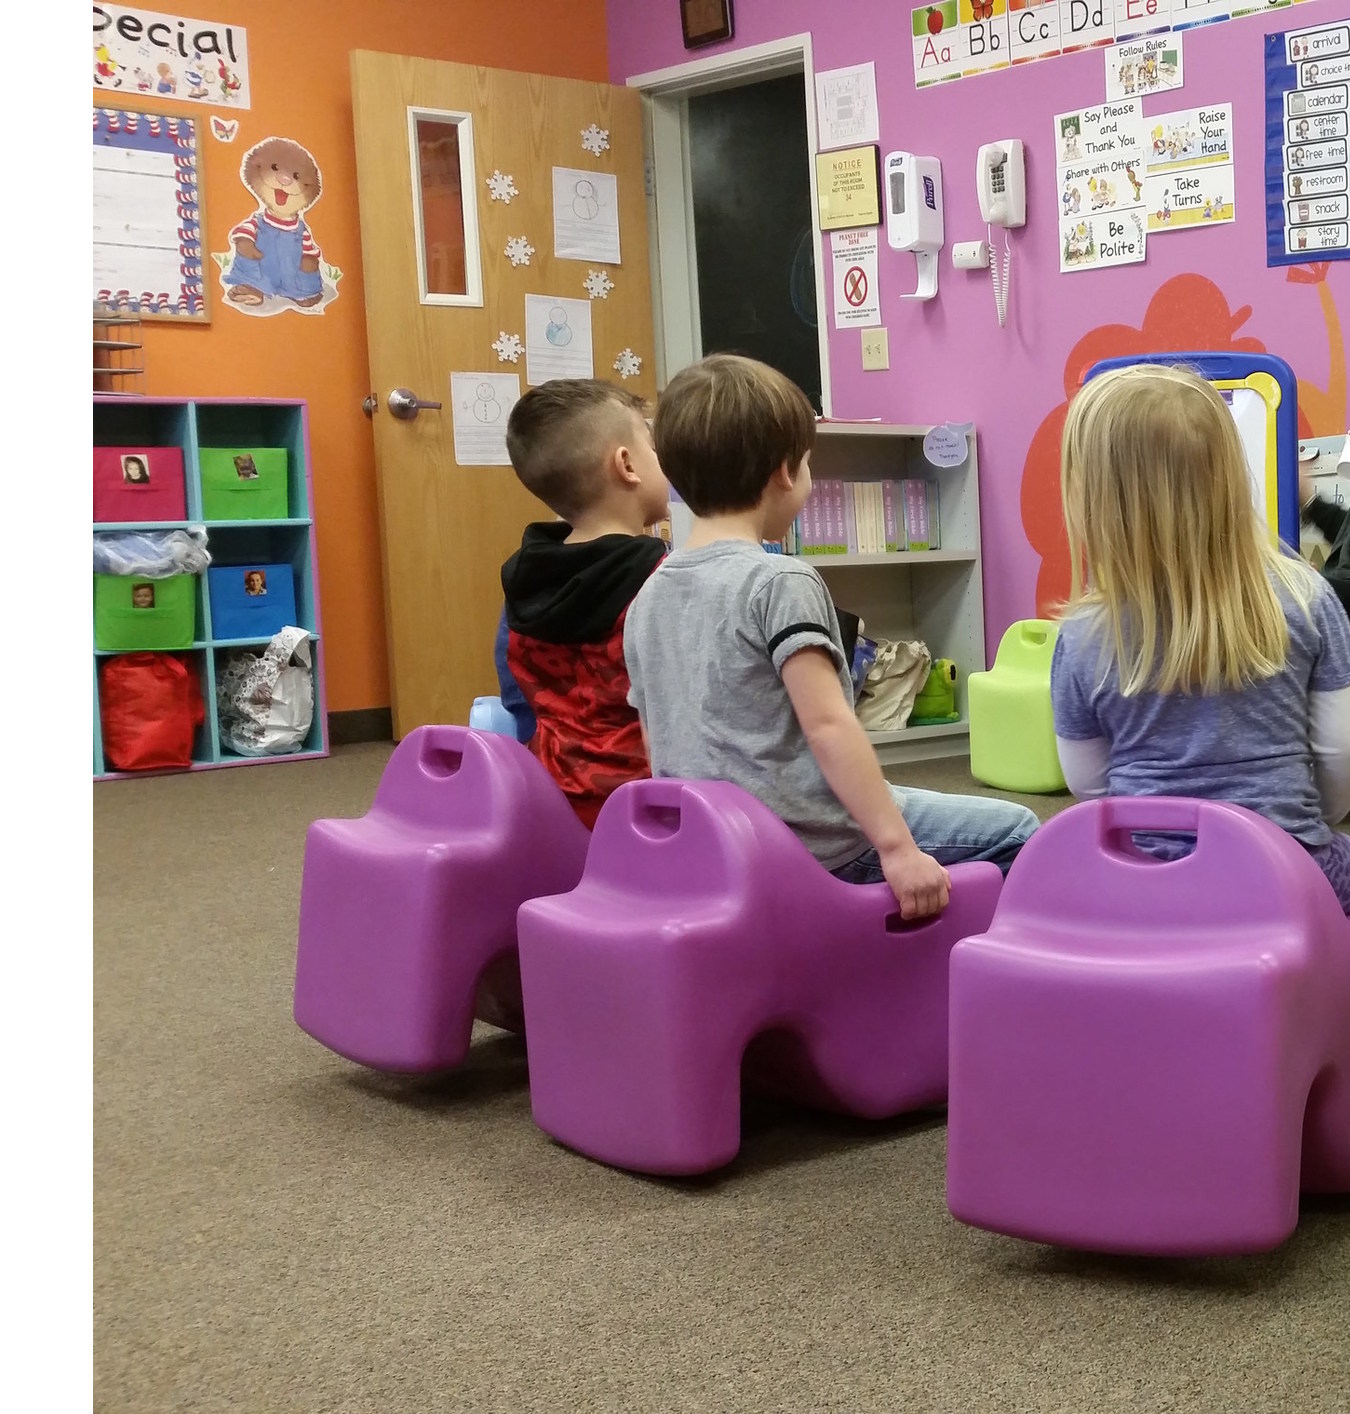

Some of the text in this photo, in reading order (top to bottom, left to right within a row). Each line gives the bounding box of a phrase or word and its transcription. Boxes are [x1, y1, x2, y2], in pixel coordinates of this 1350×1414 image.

[920, 37, 951, 68] Aa
[969, 21, 1000, 56] Bb
[1018, 11, 1049, 43] Cc
[1070, 0, 1103, 32] Dd
[1312, 33, 1341, 49] arrival
[1118, 39, 1168, 58] Follow Rules
[1320, 64, 1343, 76] choice
[1307, 93, 1345, 108] calendar
[1084, 103, 1135, 124] Say Please
[1198, 110, 1227, 125] Raise
[1099, 122, 1118, 136] and
[1313, 116, 1341, 128] center
[1201, 128, 1225, 139] Your
[1319, 127, 1338, 138] time
[1085, 135, 1136, 155] Thank You
[1200, 141, 1228, 155] Hand
[1305, 147, 1346, 160] free time
[832, 158, 862, 170] NOTICE
[1065, 157, 1142, 180] Share with Others
[834, 171, 861, 180] OCCUPANTS
[1306, 174, 1344, 188] restroom
[1174, 177, 1200, 191] Take
[1172, 193, 1203, 208] Turns
[1315, 201, 1341, 215] snack
[1108, 221, 1125, 238] Be
[1317, 227, 1340, 239] story
[1320, 237, 1338, 246] time
[1099, 244, 1136, 260] Polite
